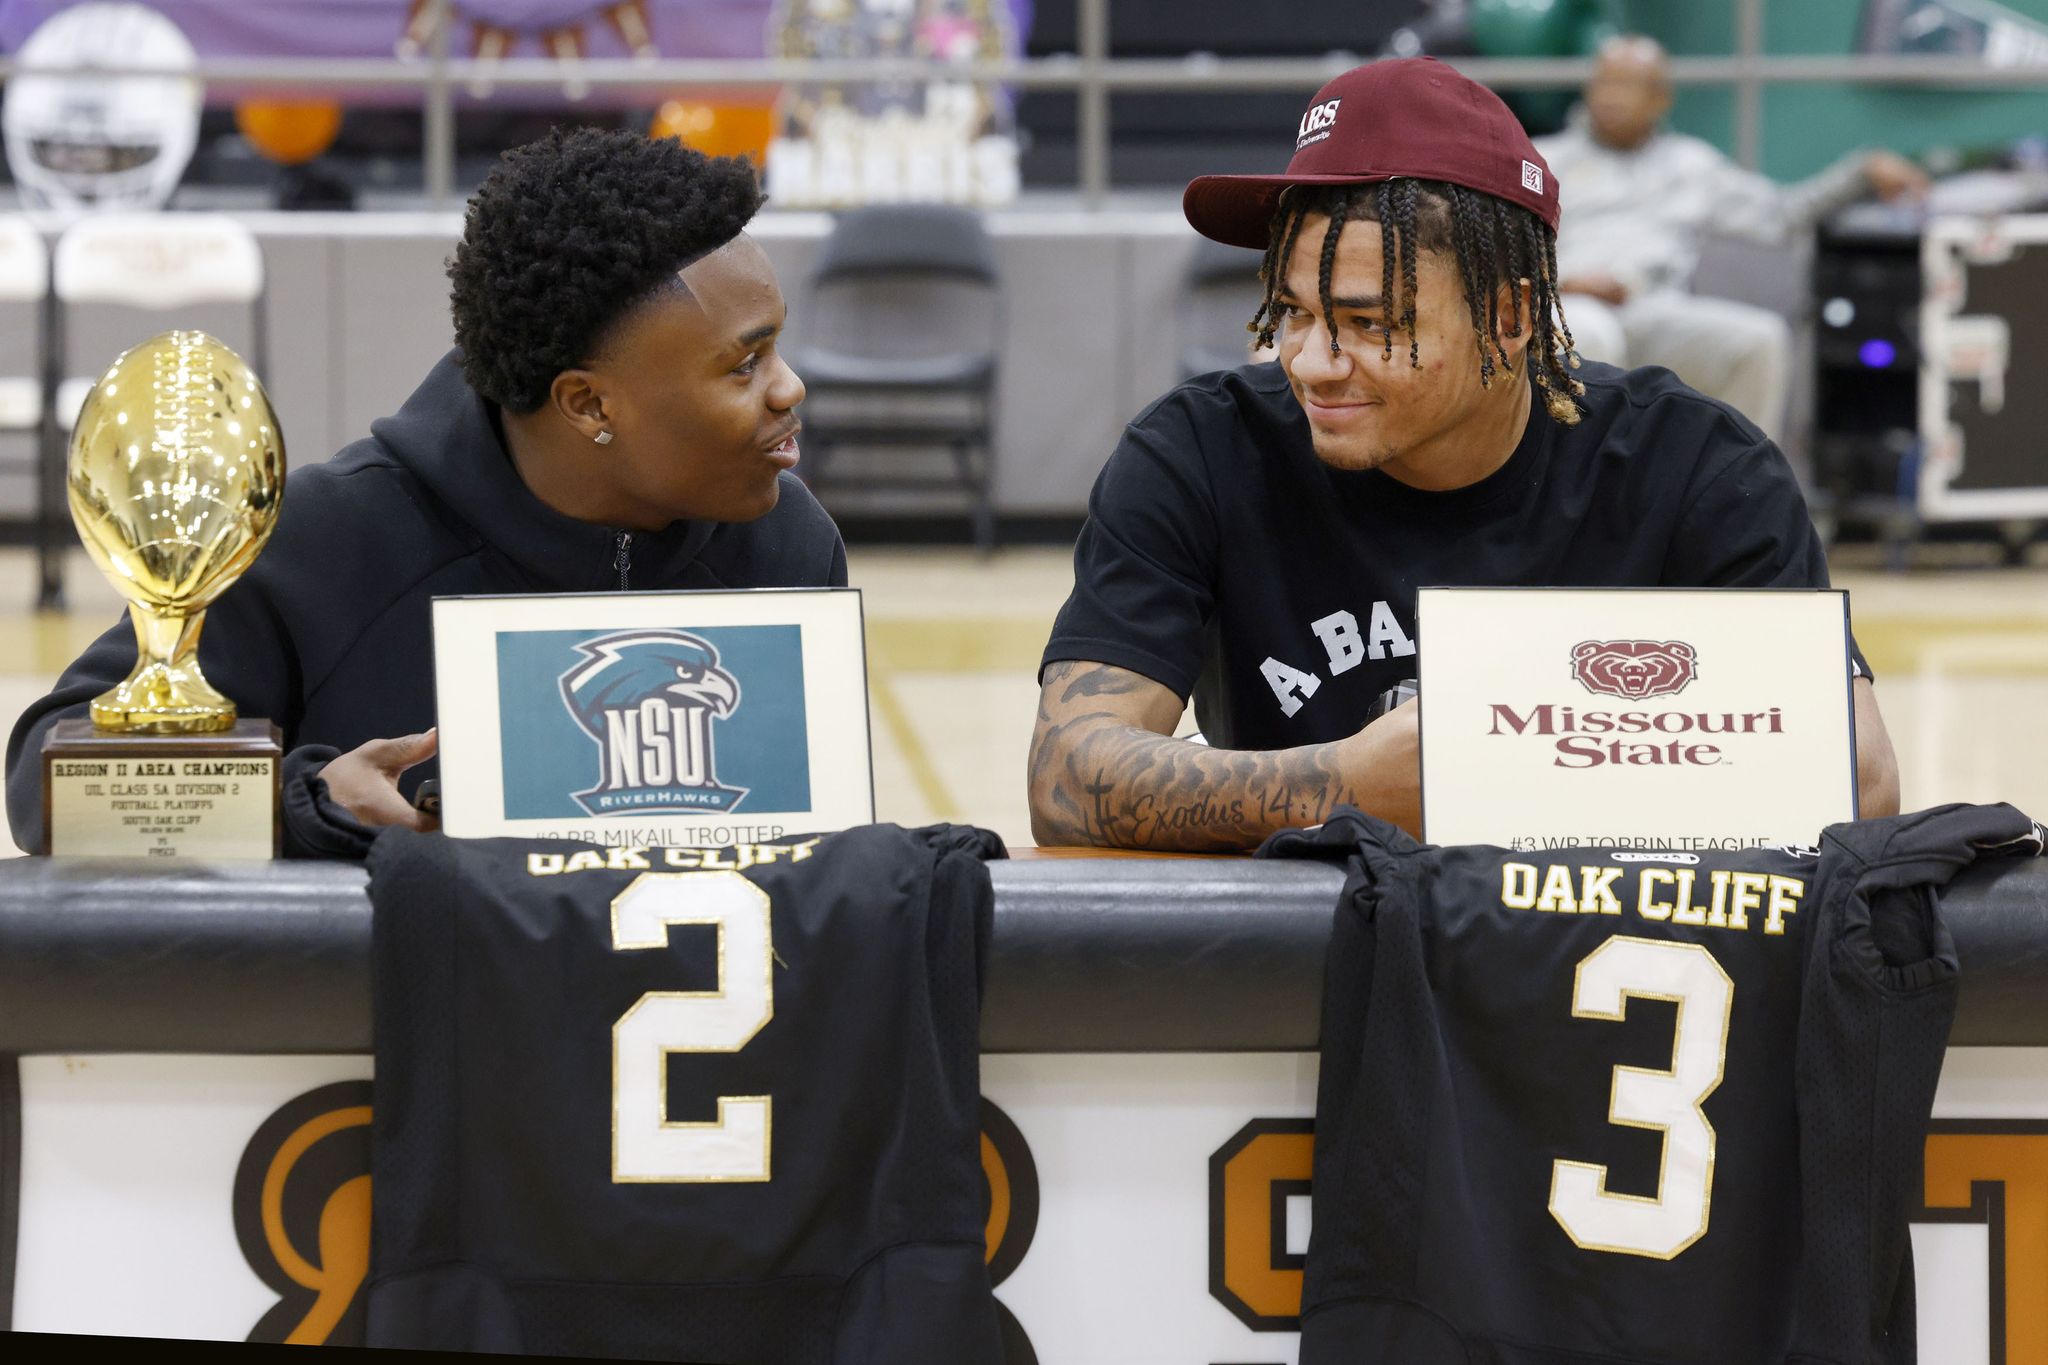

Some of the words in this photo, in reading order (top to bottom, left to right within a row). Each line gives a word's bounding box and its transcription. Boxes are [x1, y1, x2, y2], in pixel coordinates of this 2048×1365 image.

[1259, 656, 1322, 719] A
[1310, 600, 1416, 677] BA
[1487, 703, 1786, 735] Missouri
[604, 698, 710, 790] NSU
[1554, 736, 1722, 768] State
[55, 764, 108, 777] REGION
[117, 764, 127, 776] II
[136, 764, 175, 776] AREA
[183, 763, 269, 776] CHAMPIONS
[111, 784, 148, 796] CLASS
[175, 784, 226, 796] DIVISION
[231, 784, 240, 796] 2
[605, 829, 680, 847] MIKAIL
[685, 826, 784, 844] TROTTER
[1132, 792, 1245, 846] Exodus
[527, 847, 651, 876] OAK
[1501, 862, 1623, 914] OAK
[1637, 868, 1804, 935] CLIFF
[610, 869, 774, 1183] 2
[1548, 934, 1735, 1261] 3
